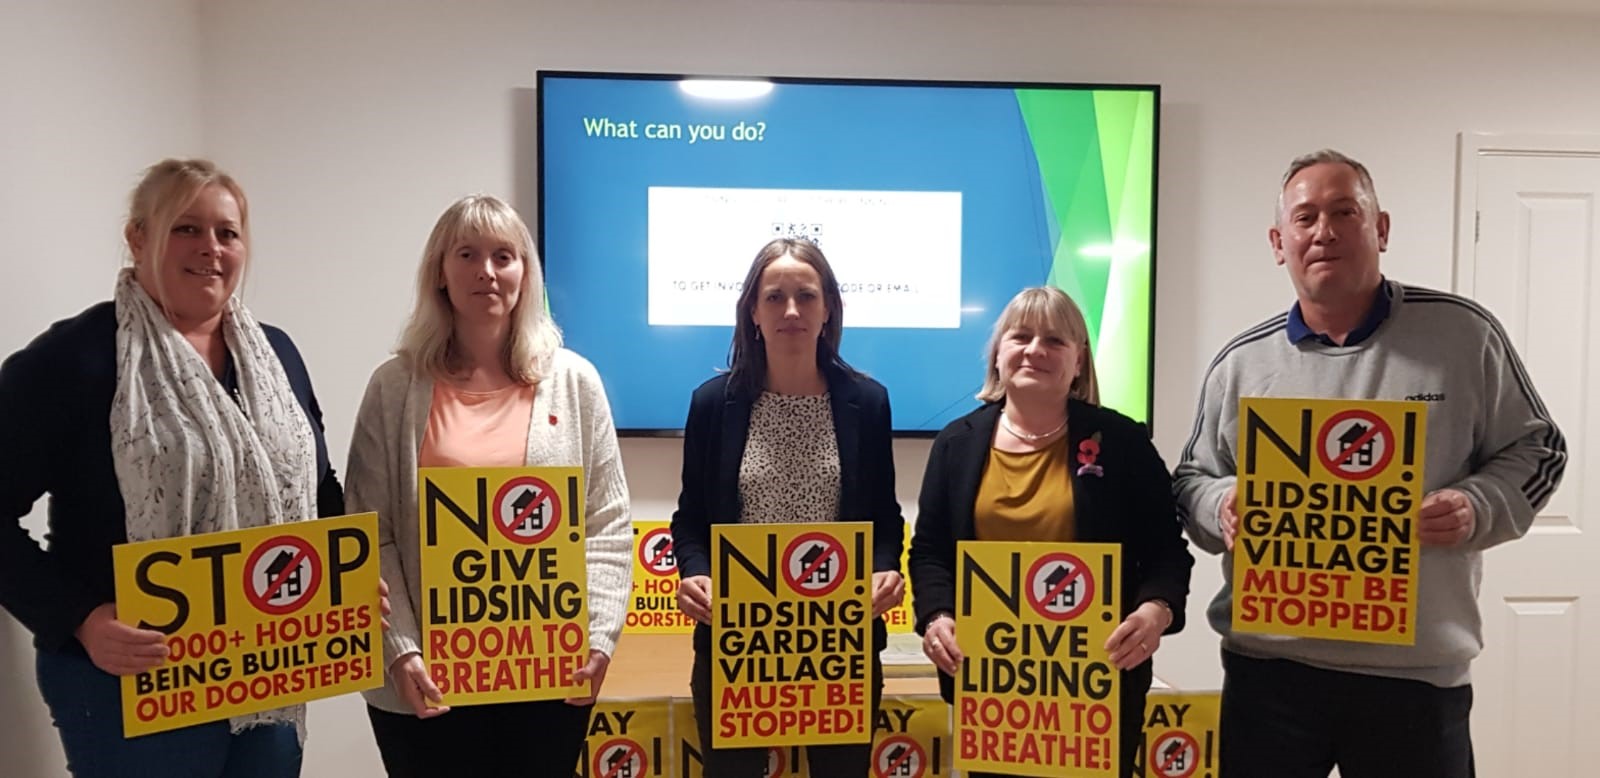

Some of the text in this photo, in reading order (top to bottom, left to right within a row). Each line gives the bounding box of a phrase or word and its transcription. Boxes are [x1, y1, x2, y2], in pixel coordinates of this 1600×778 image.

[583, 117, 767, 144] What can you do?
[1245, 406, 1417, 482] NO!
[425, 476, 580, 546] NO!
[1246, 480, 1412, 515] LIDSING
[1243, 510, 1411, 544] GARDEN
[452, 548, 558, 583] GIVE
[719, 532, 865, 598] NO!
[1242, 538, 1411, 575] VILLAGE
[135, 528, 370, 635] STOP
[962, 550, 1113, 622] NO!
[1242, 568, 1409, 603] MUST BE
[429, 582, 582, 625] LIDSING
[720, 599, 865, 628] LIDSING
[1240, 595, 1407, 634] STOPPED!
[167, 605, 372, 662] 000+ HOUSES
[430, 622, 584, 660] ROOM TO
[719, 628, 865, 656] GARDEN
[985, 622, 1089, 659] GIVE
[136, 632, 371, 695] BEING BUILT ON
[431, 655, 585, 694] BREATHE!
[719, 655, 865, 683] VILLAGE
[962, 656, 1112, 700] LIDSING
[136, 656, 373, 722] OUR DOORSTEPS!
[720, 683, 864, 710] MUST BE
[588, 711, 636, 736] AY
[719, 709, 865, 738] STOPPED!
[876, 709, 916, 733] AY
[960, 697, 1112, 735] ROOM TO
[1147, 704, 1192, 728] AY
[960, 729, 1111, 770] BREATHE!
